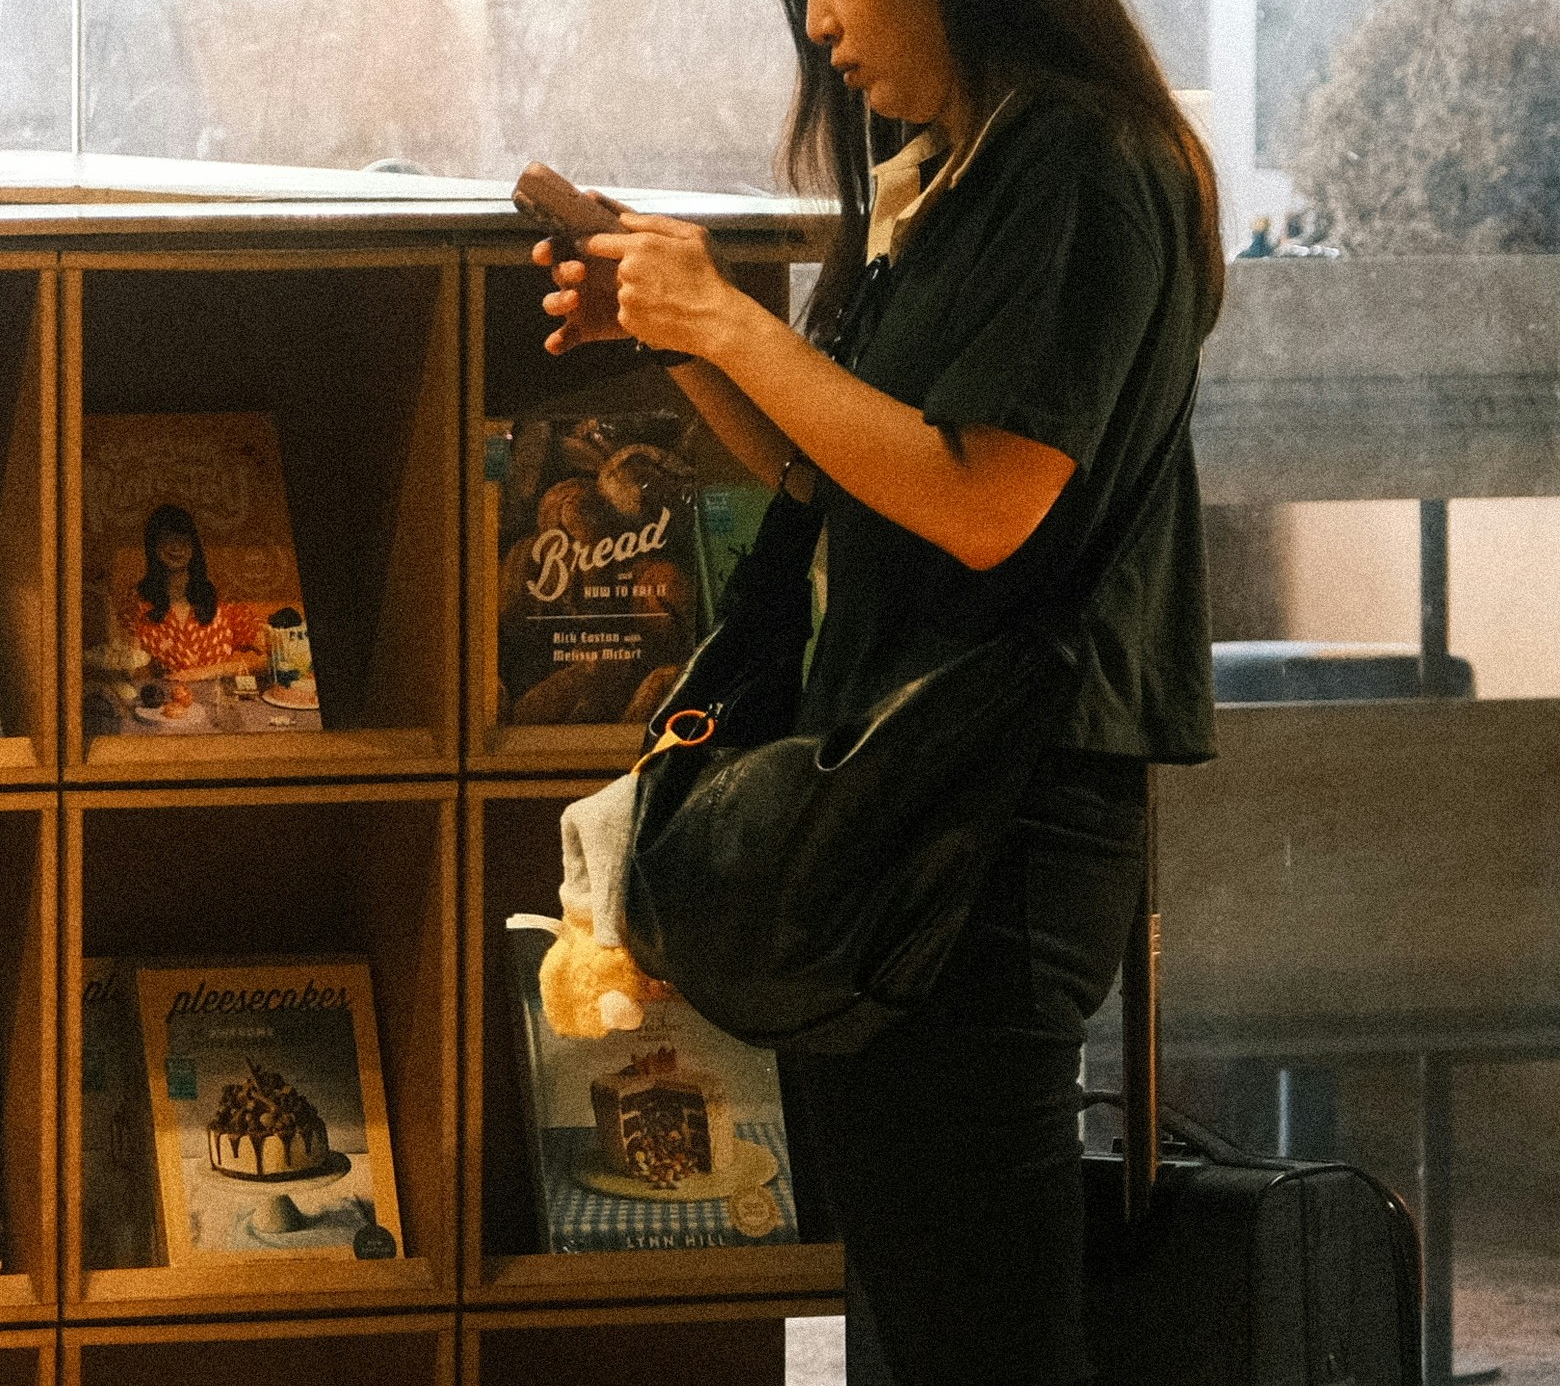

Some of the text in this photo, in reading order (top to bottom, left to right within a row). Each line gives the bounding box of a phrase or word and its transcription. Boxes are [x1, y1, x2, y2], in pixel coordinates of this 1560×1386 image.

[526, 506, 671, 602] Bread
[166, 980, 351, 1024] pleesecakes
[627, 1234, 727, 1249] LYNN HILL
